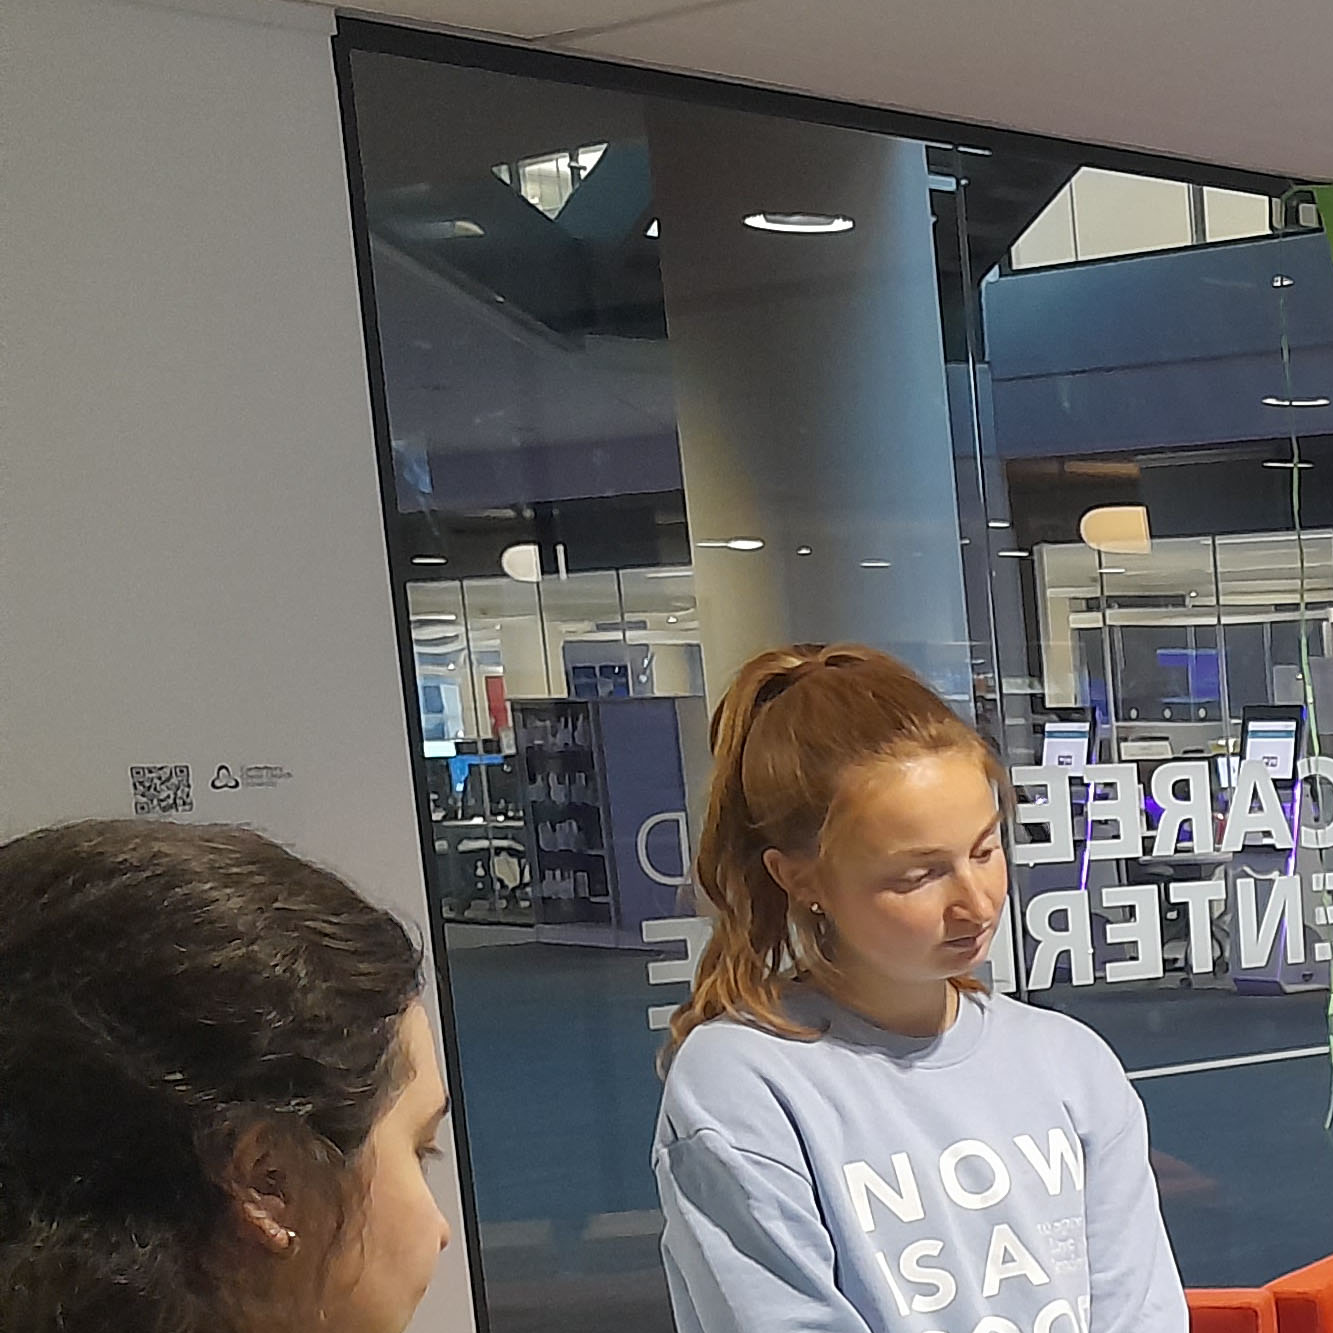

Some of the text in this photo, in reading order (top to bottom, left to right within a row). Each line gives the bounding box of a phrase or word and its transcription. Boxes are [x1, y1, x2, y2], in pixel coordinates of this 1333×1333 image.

[843, 1128, 1086, 1233] NOW
[876, 1239, 957, 1318] IS
[982, 1223, 1050, 1298] A
